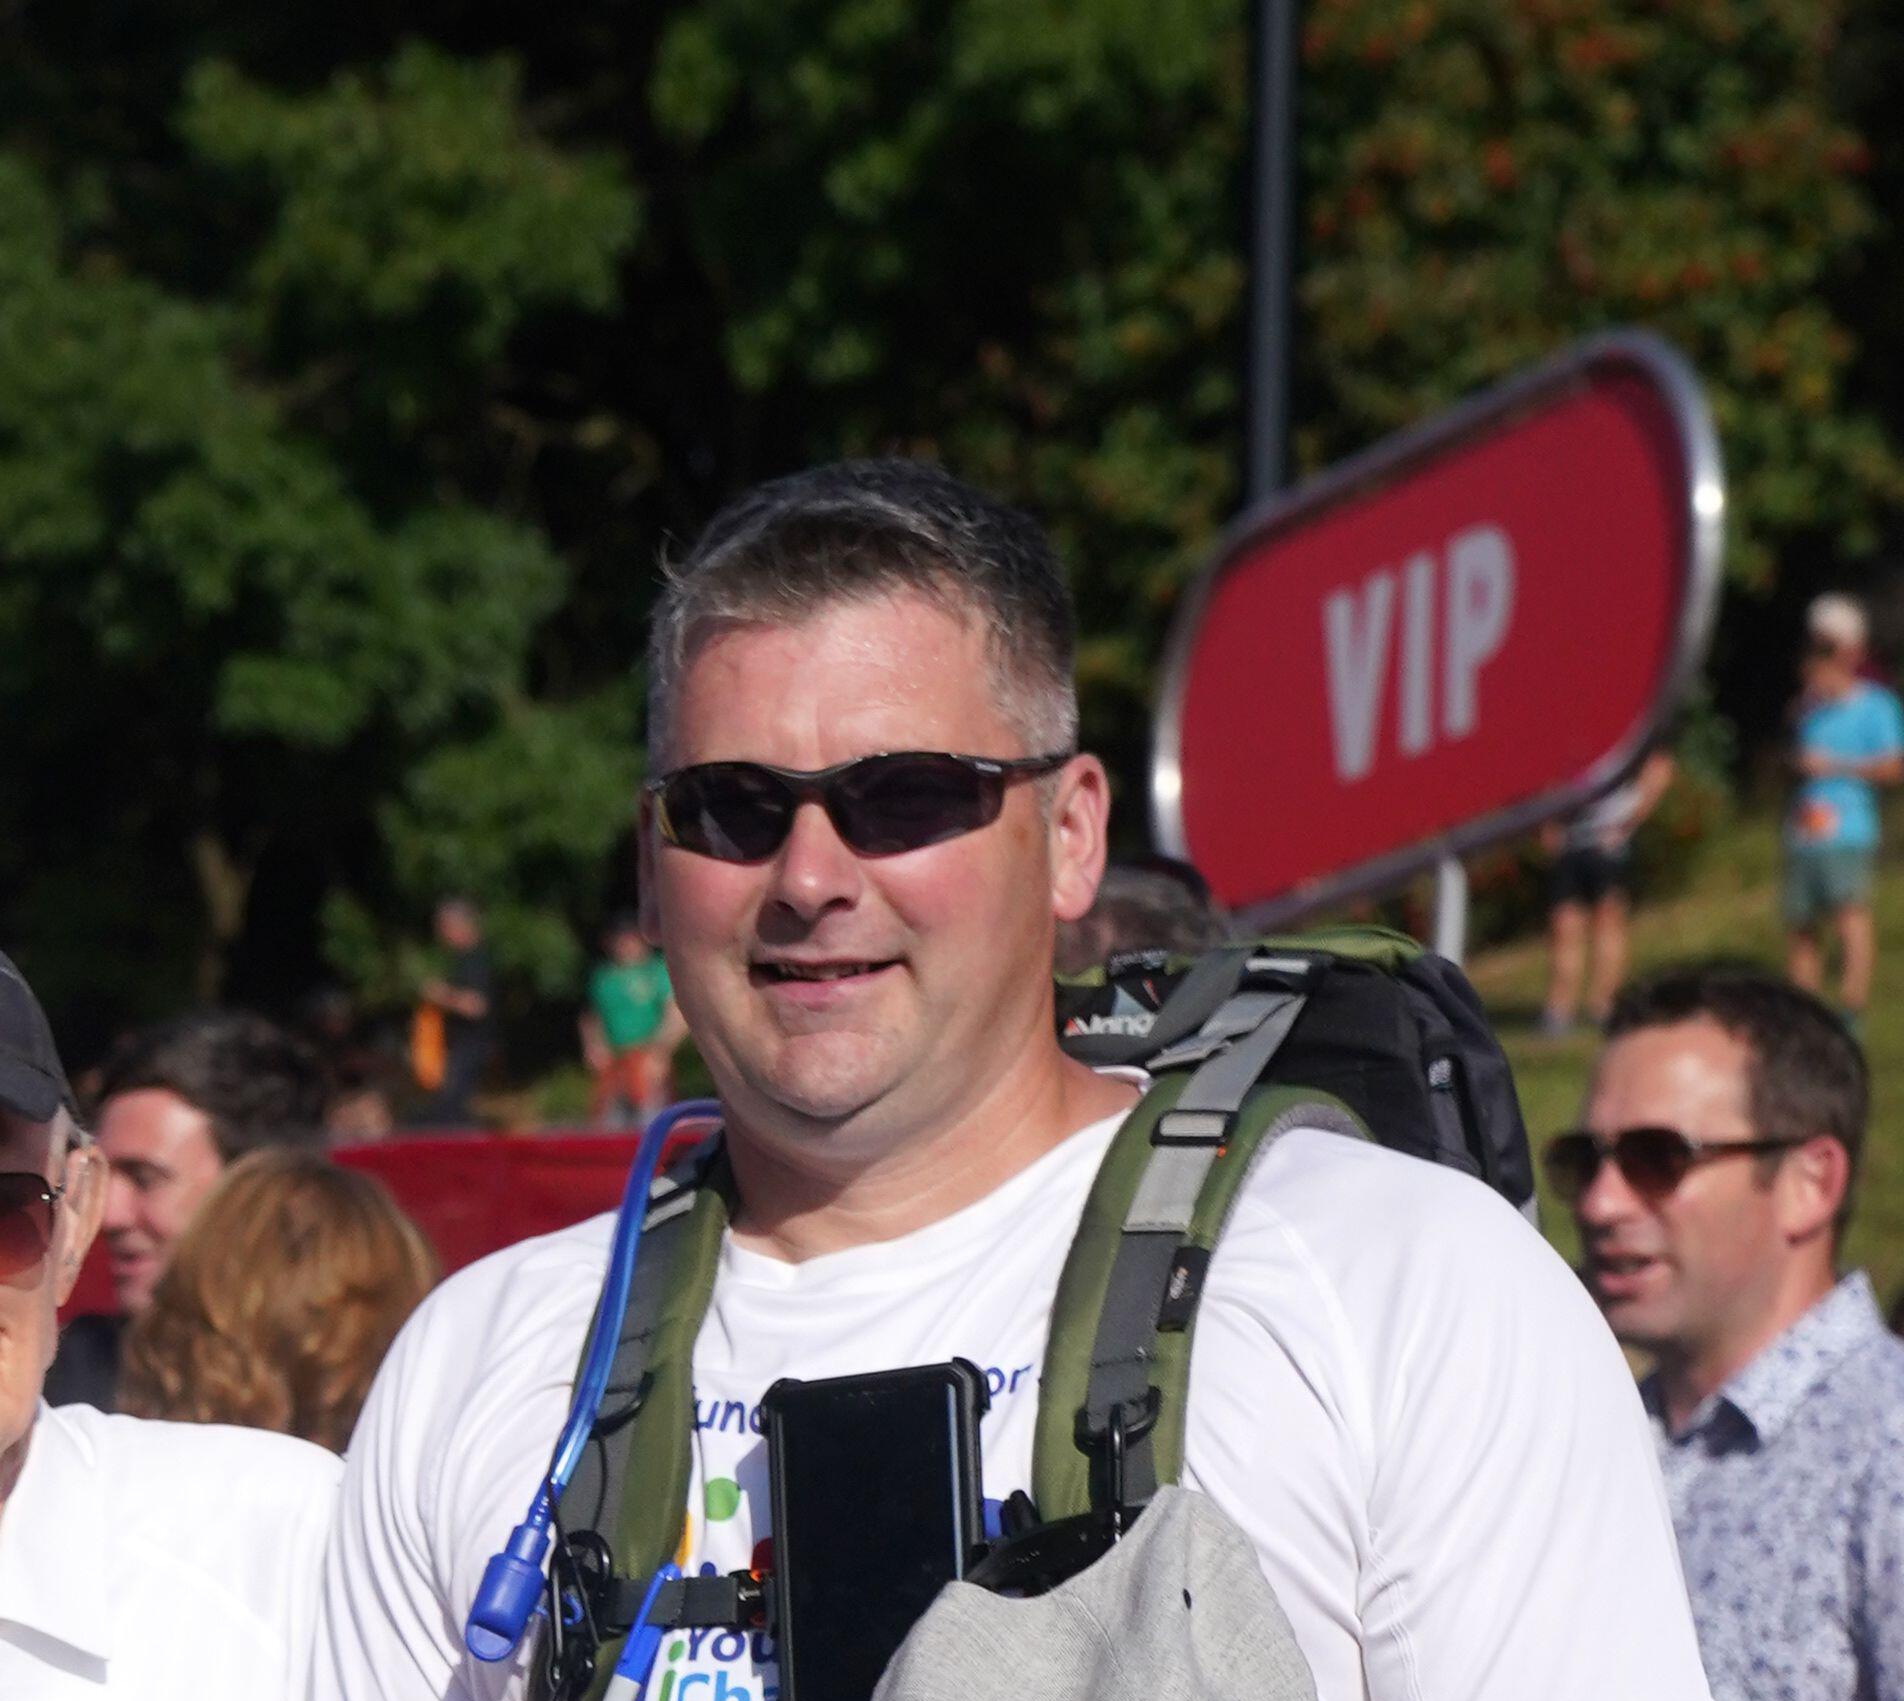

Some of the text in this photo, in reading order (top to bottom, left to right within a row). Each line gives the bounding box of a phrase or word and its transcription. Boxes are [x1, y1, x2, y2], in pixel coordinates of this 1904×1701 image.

[1322, 523, 1516, 781] VIP
[986, 1363, 1034, 1397] or
[688, 1626, 779, 1664] You
